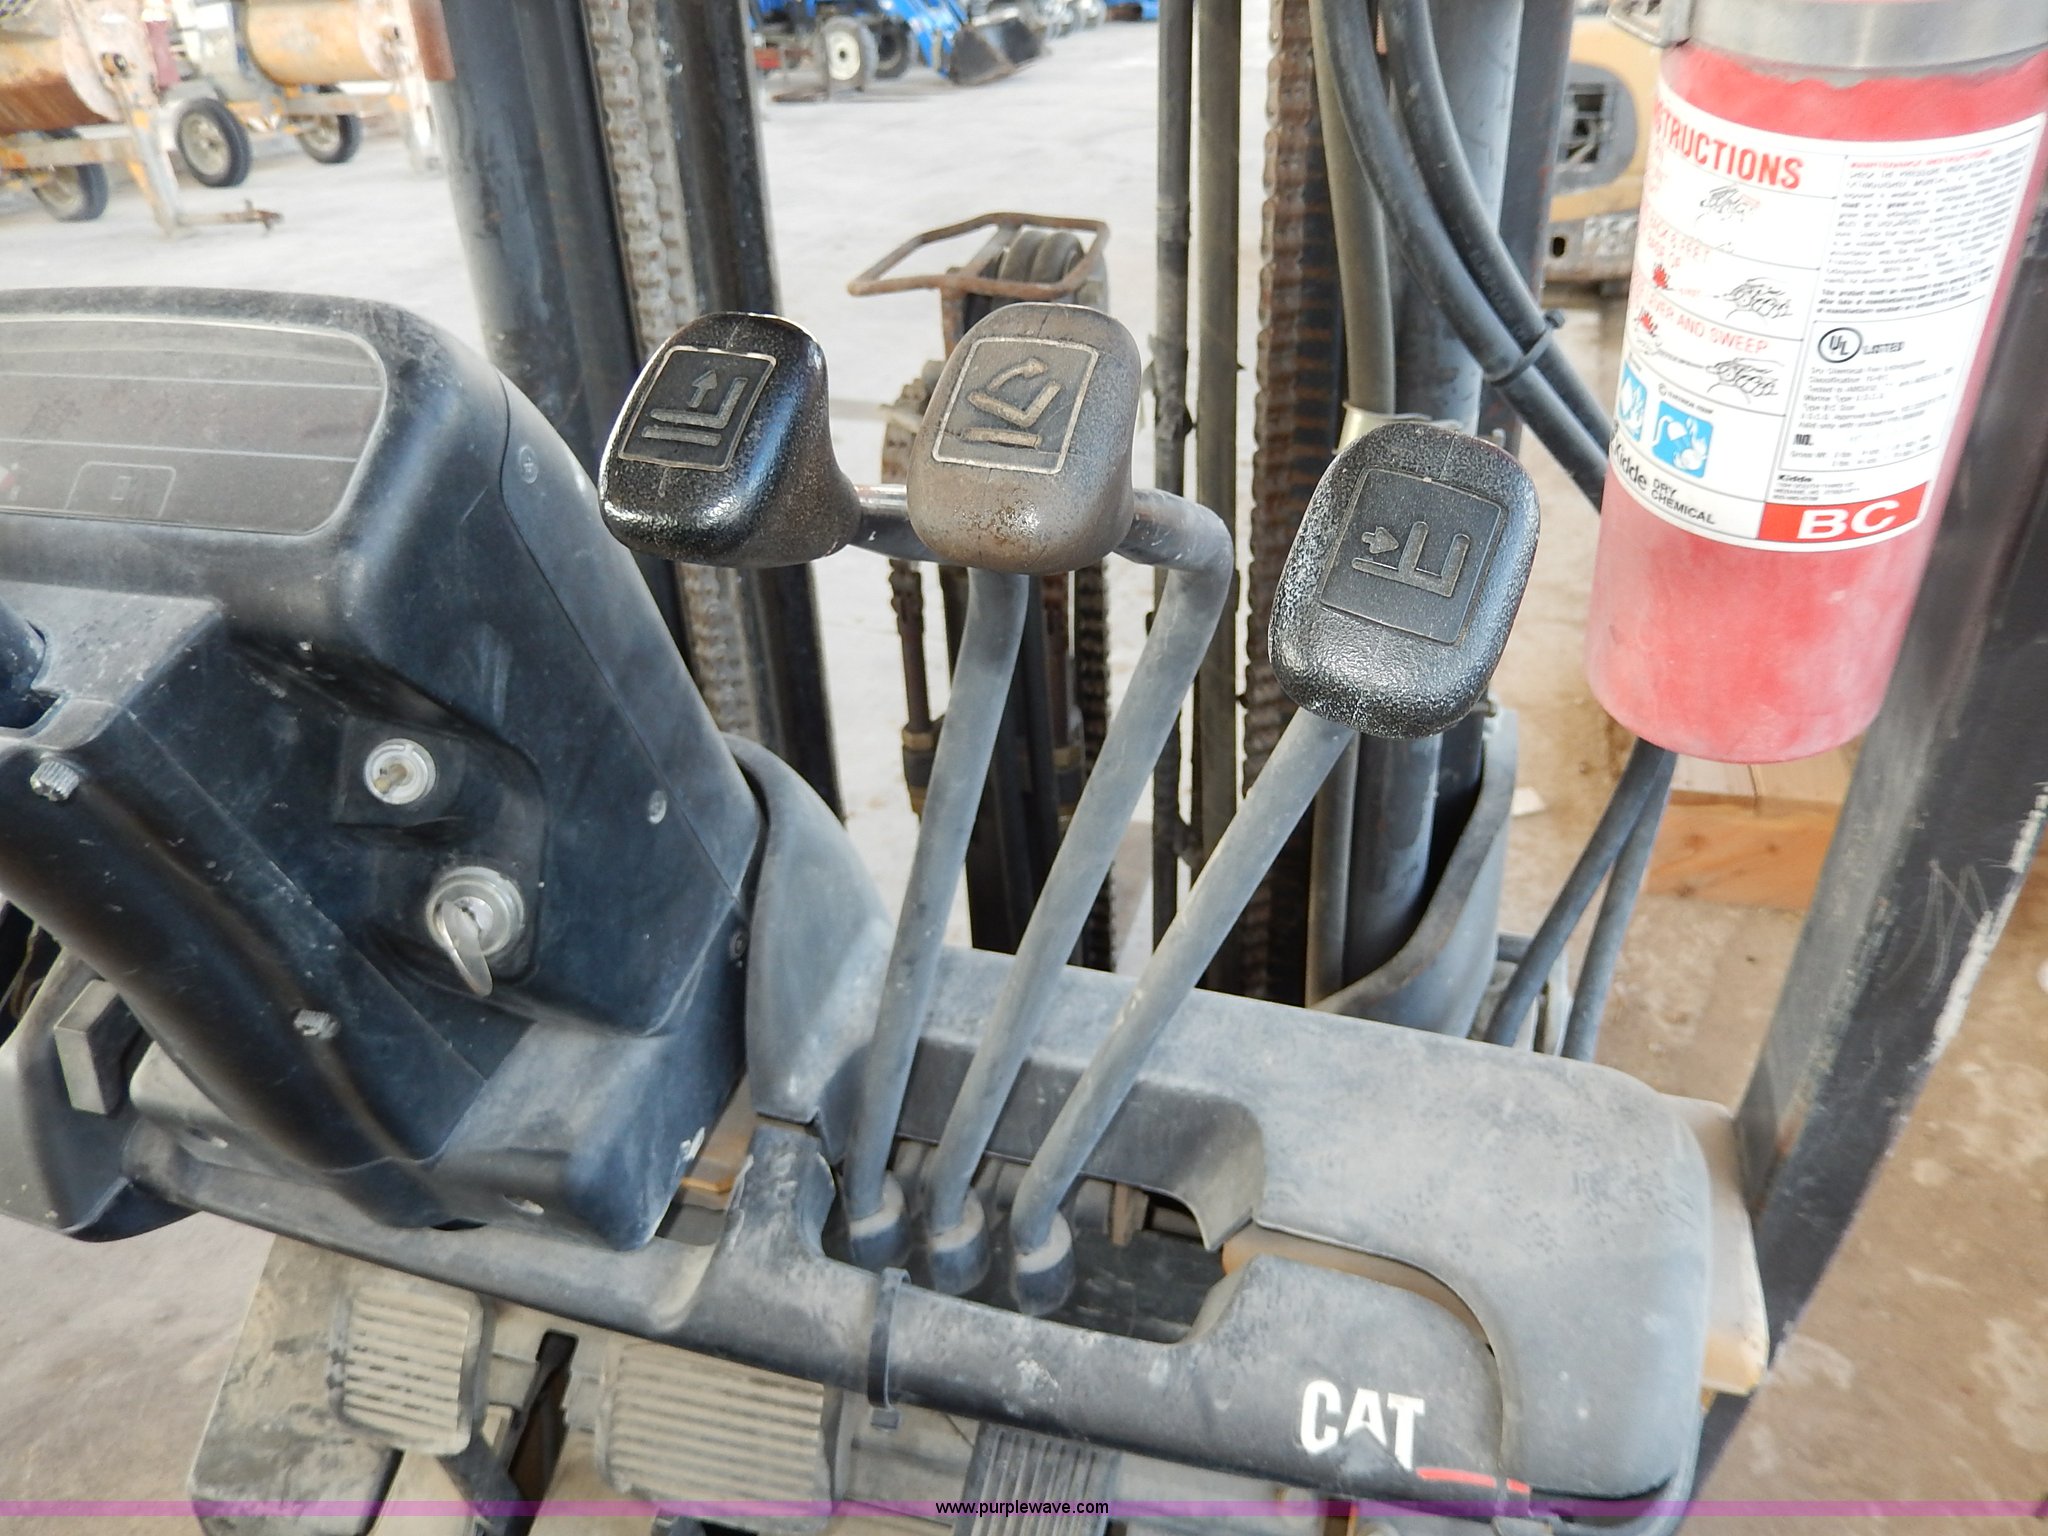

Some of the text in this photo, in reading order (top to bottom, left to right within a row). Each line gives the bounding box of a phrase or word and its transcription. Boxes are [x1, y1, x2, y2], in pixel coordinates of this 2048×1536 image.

[1710, 326, 1768, 354] SWEEP
[1651, 488, 1716, 525] CHEMICAL
[1652, 478, 1677, 498] DRY
[1797, 499, 1900, 540] BC
[1300, 1379, 1426, 1471] CAT
